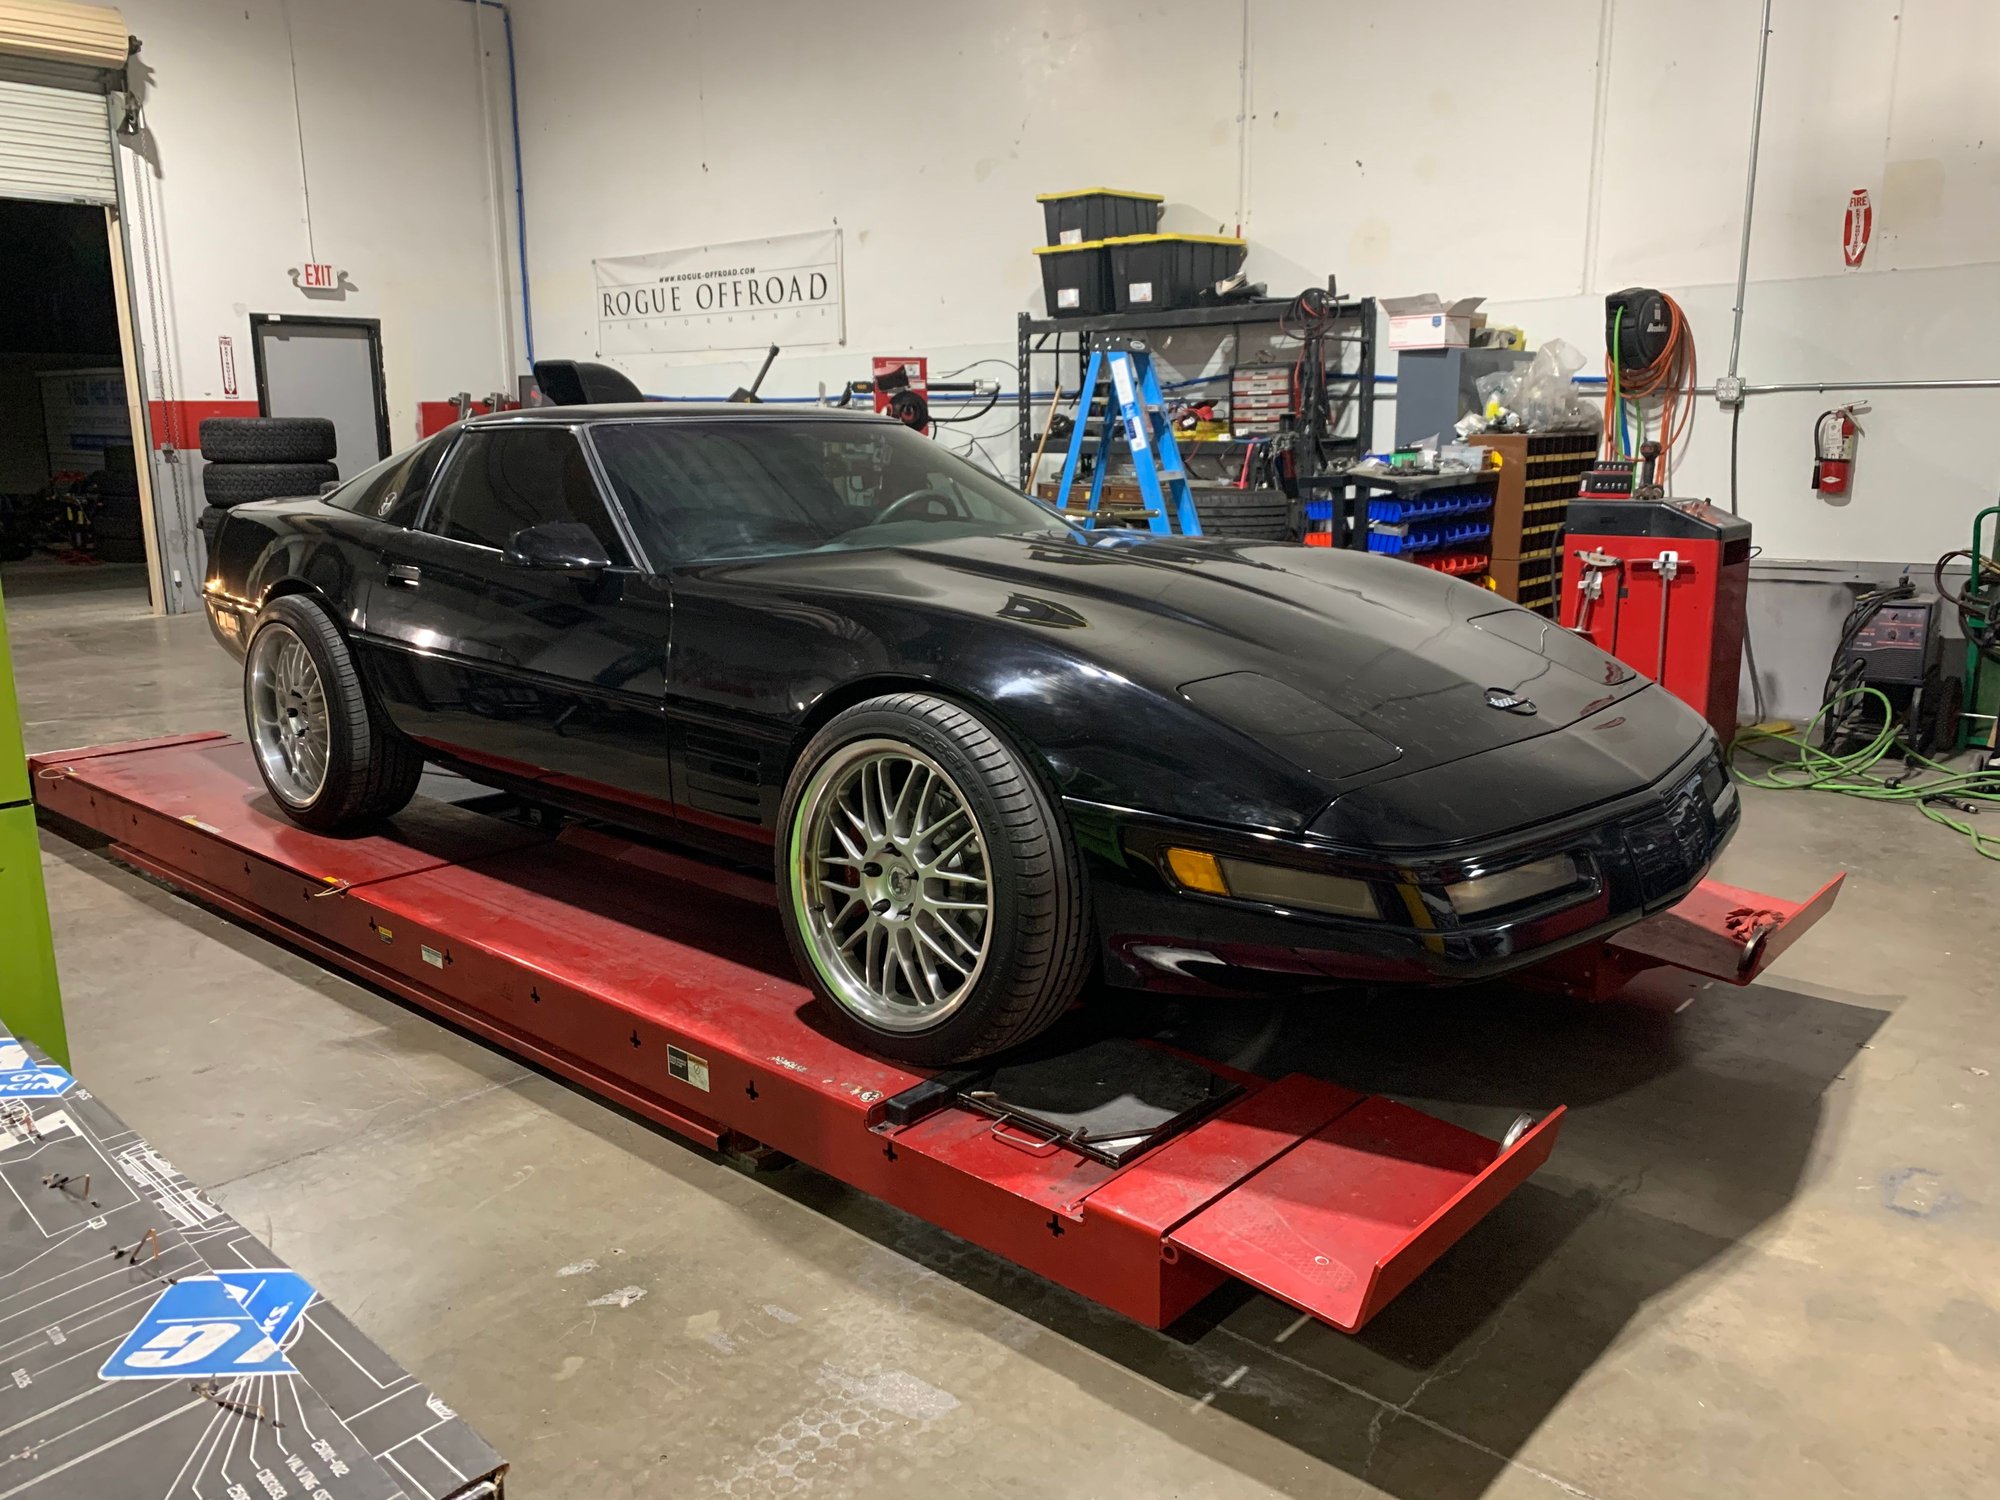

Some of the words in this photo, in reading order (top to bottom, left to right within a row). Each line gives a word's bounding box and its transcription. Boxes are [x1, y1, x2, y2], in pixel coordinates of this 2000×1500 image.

[1850, 196, 1867, 207] FIRE
[305, 264, 332, 286] EXIT
[659, 266, 755, 283] WWW.ROGUE-OFFROAD.COM
[603, 286, 682, 317] ROGUE
[696, 272, 828, 310] OFFROAD
[285, 1453, 321, 1491] VALVING
